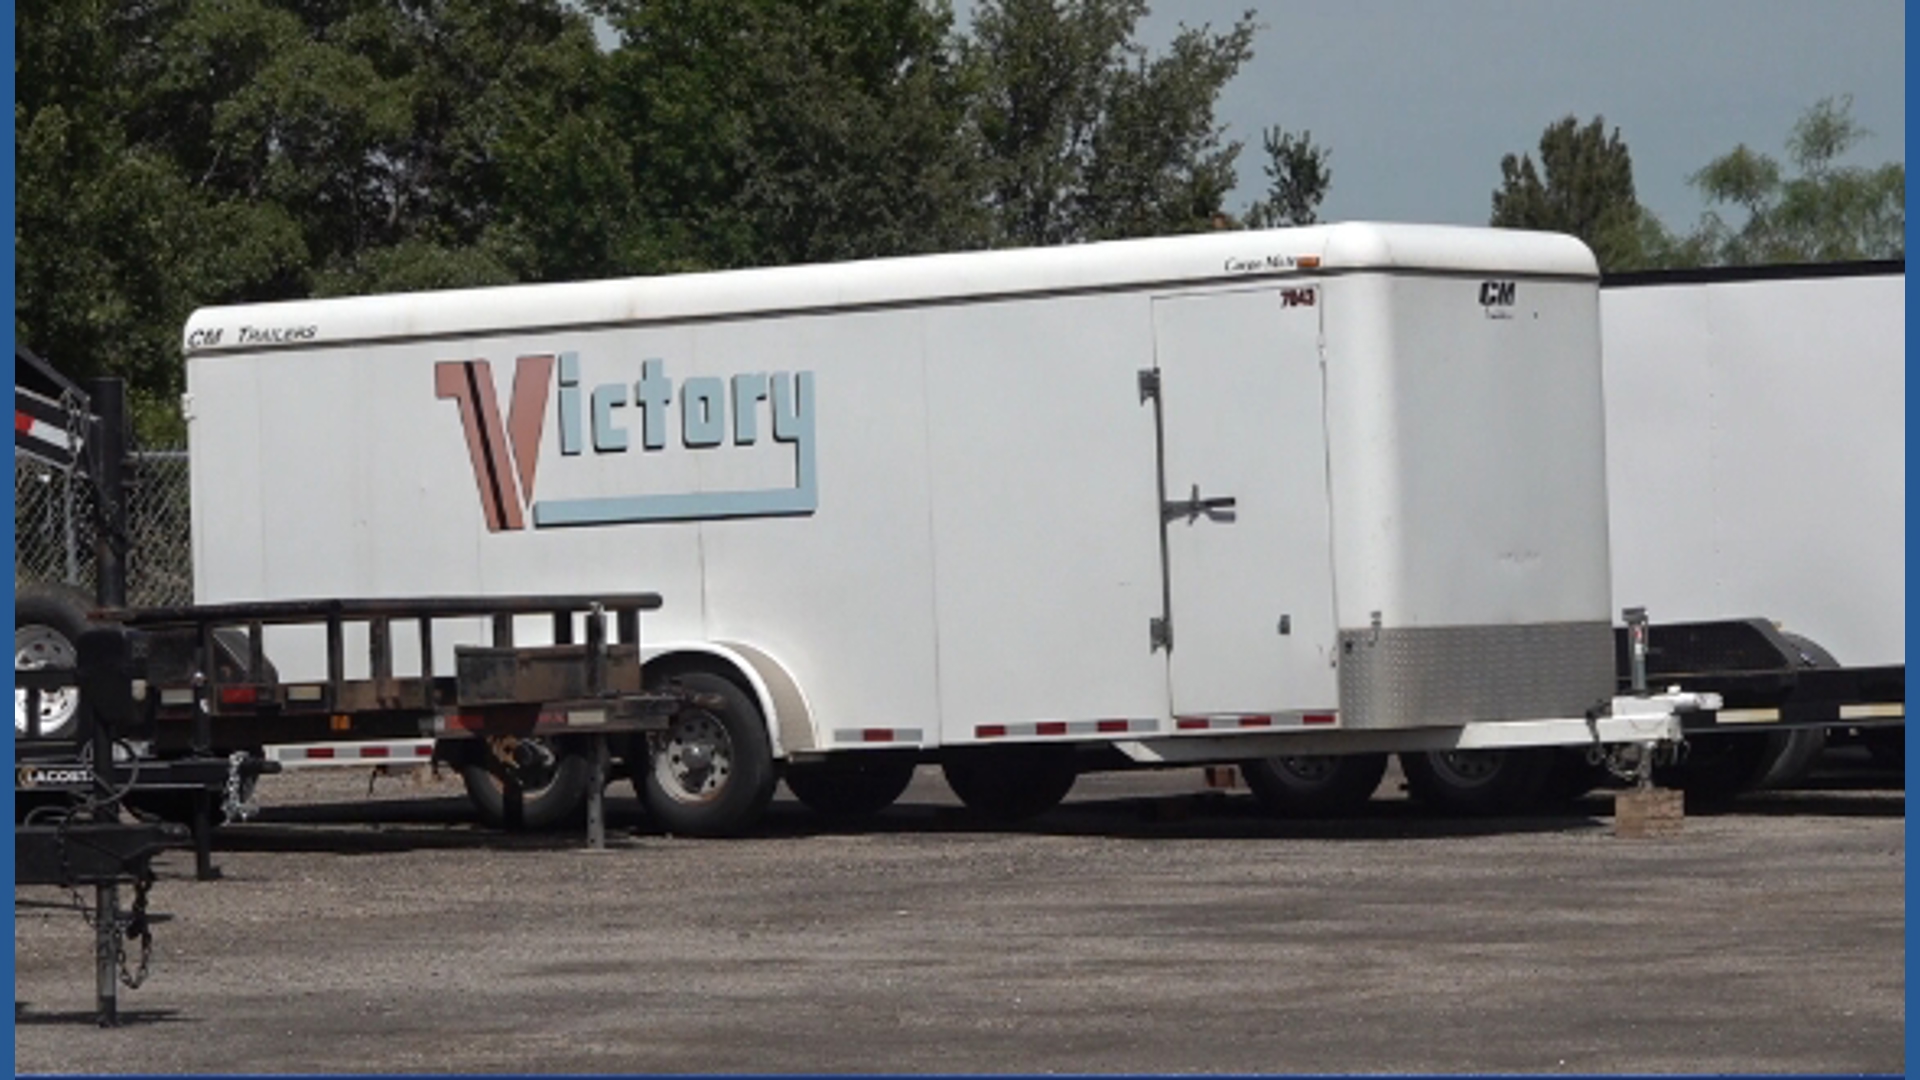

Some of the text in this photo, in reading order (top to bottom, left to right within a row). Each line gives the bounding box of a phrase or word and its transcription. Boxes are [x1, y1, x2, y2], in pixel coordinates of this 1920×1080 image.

[1479, 281, 1515, 306] CM
[187, 328, 224, 347] CM
[435, 351, 818, 533] Victory
